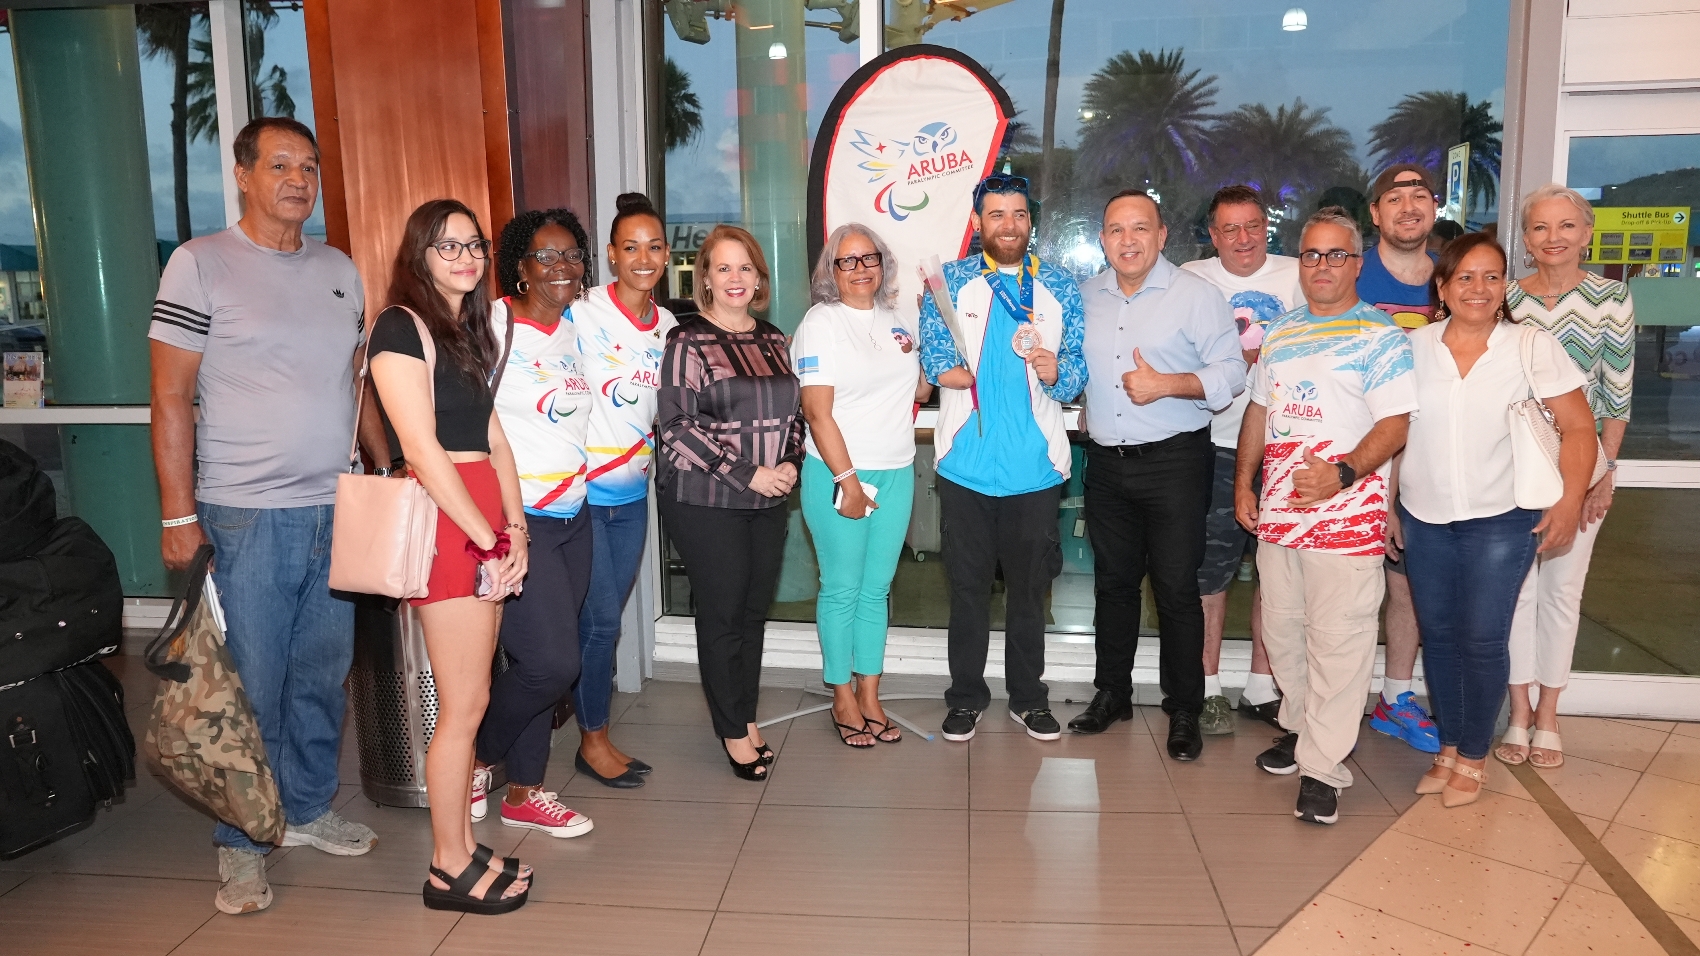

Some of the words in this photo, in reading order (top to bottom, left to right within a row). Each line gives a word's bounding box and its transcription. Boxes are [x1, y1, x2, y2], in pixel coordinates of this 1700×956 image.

[908, 150, 973, 180] ARUBA
[907, 173, 940, 186] PARALYMPIC
[941, 164, 974, 177] COMMITTEE
[1453, 164, 1460, 192] P
[1622, 211, 1652, 219] Shuttle
[1654, 211, 1670, 219] Bus
[672, 226, 708, 248] He
[564, 378, 590, 391] ARUB
[631, 369, 658, 386] ARU
[1283, 403, 1322, 418] ARUBA
